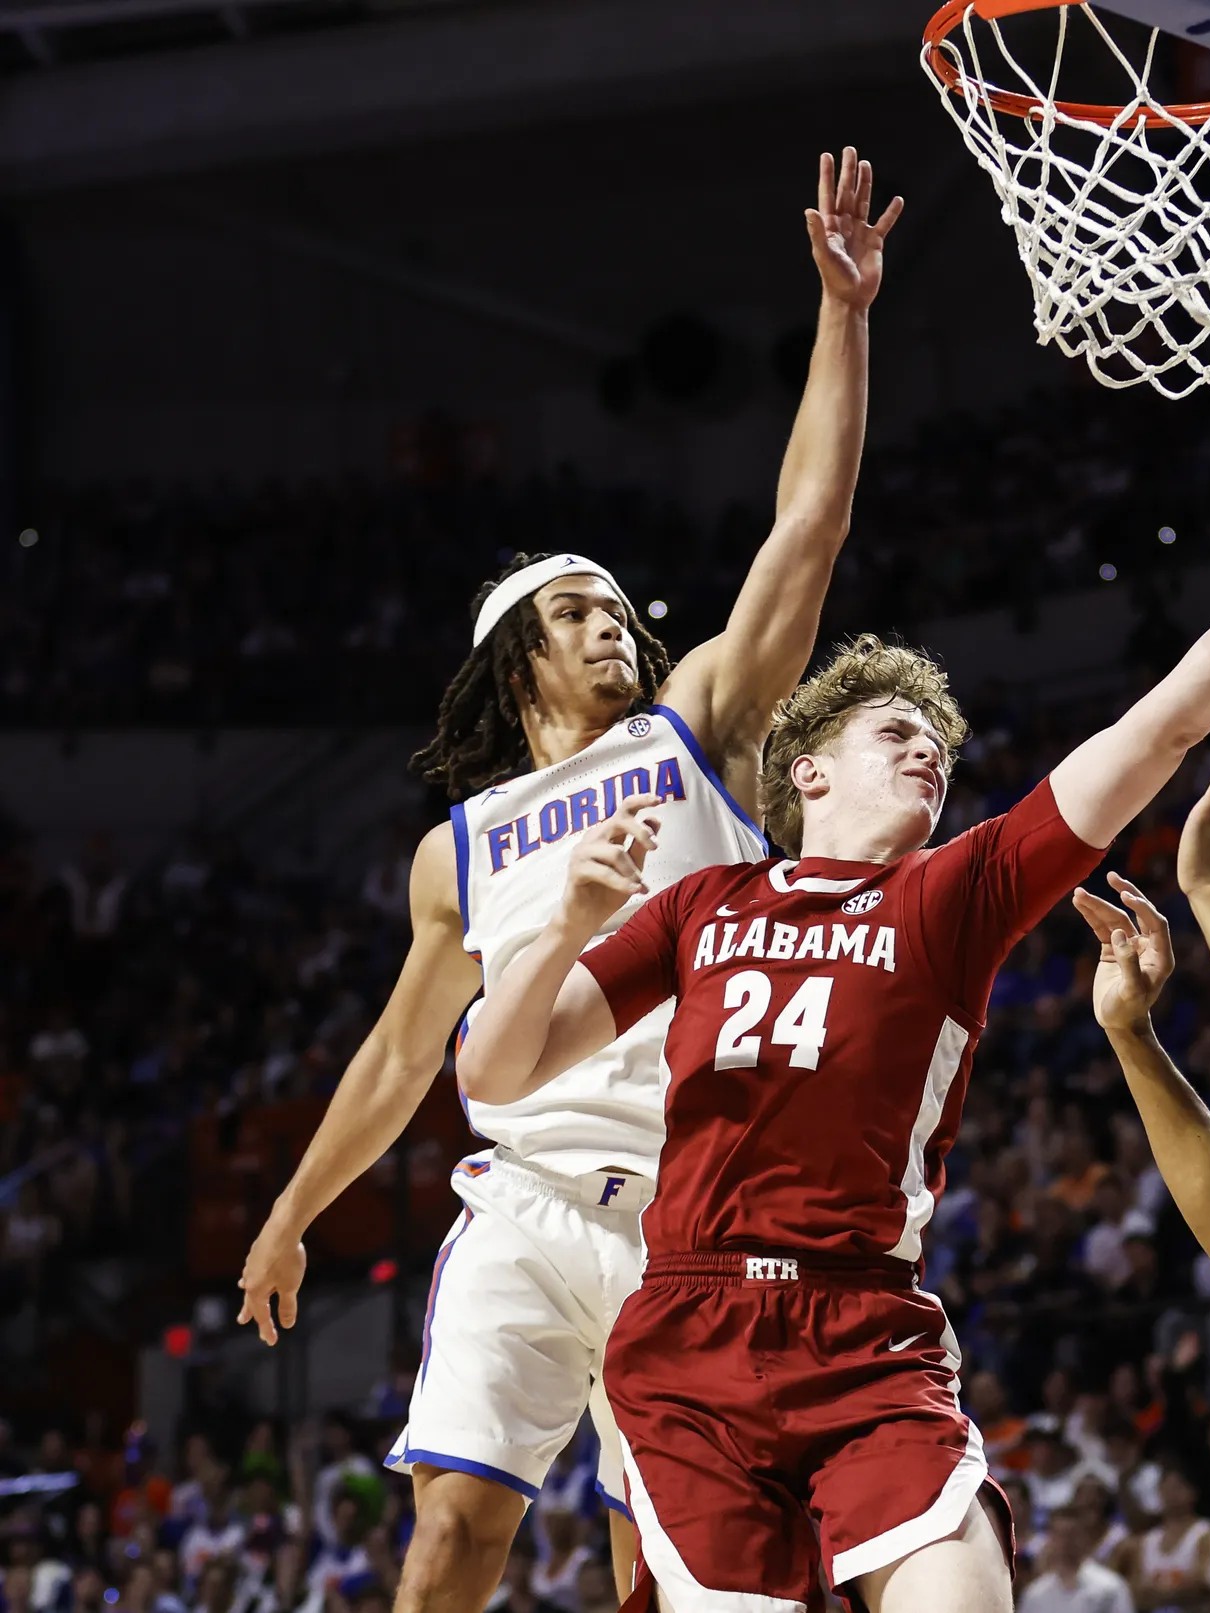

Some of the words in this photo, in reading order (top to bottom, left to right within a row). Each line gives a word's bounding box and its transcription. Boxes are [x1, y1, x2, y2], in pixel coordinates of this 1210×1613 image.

[628, 718, 650, 737] SEC
[845, 890, 881, 914] SEC
[693, 917, 896, 972] ALABAMA
[714, 970, 835, 1072] 24
[597, 1176, 626, 1207] F
[745, 1257, 799, 1281] RTR
